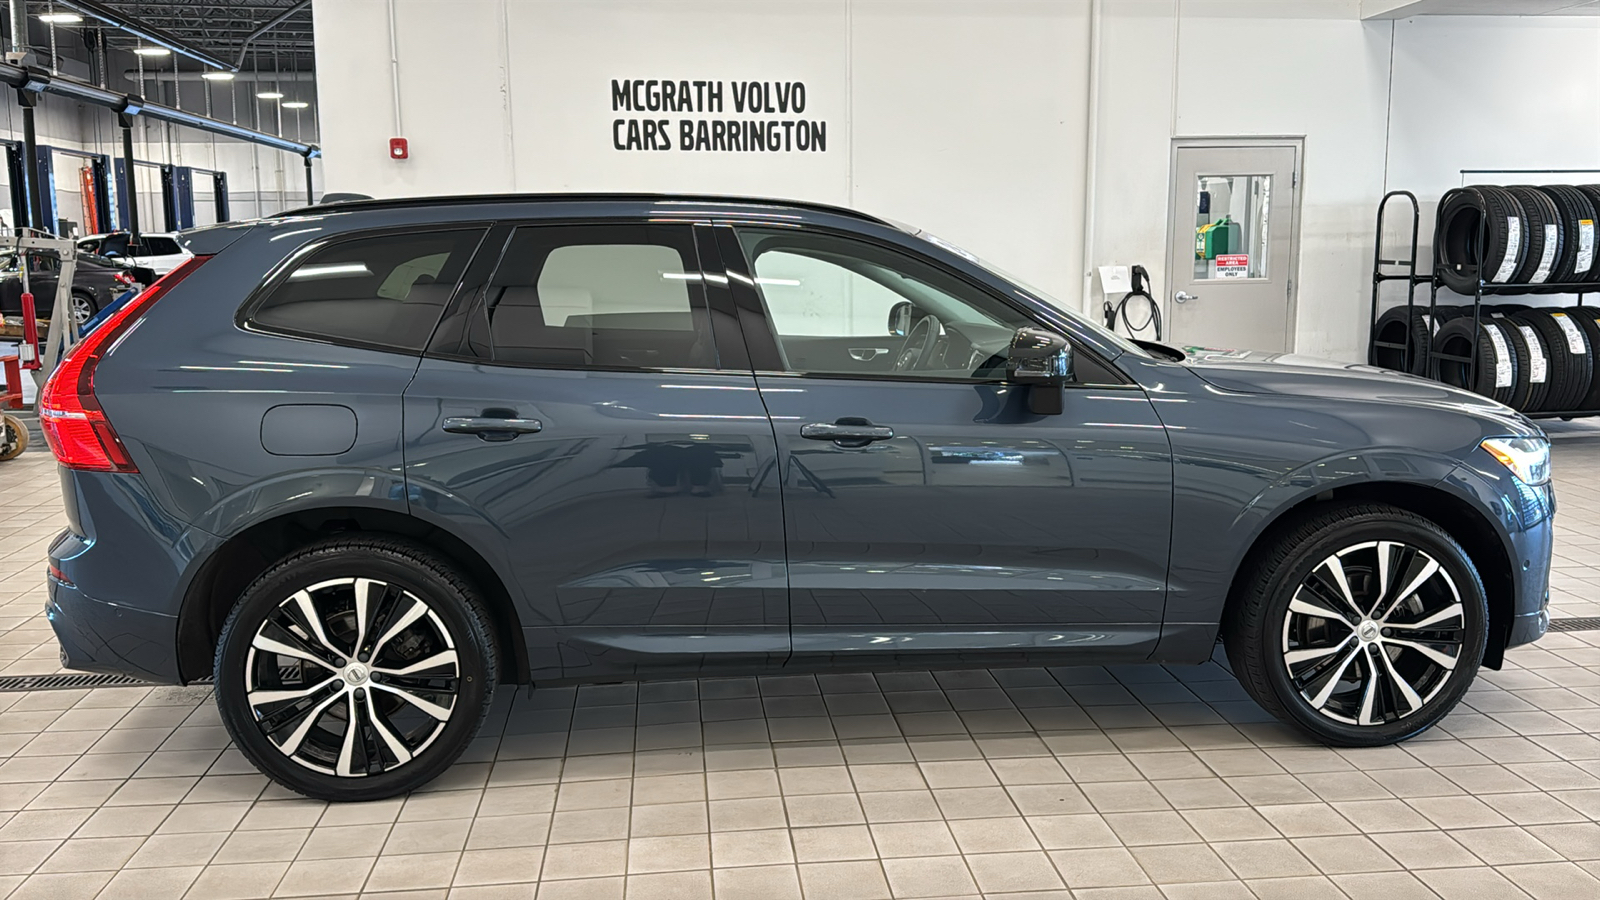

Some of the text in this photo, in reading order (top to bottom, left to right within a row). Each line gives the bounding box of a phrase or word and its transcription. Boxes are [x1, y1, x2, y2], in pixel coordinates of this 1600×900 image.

[611, 79, 806, 113] MCGRATH VOLVO
[613, 119, 826, 152] CARS BARRINGTON
